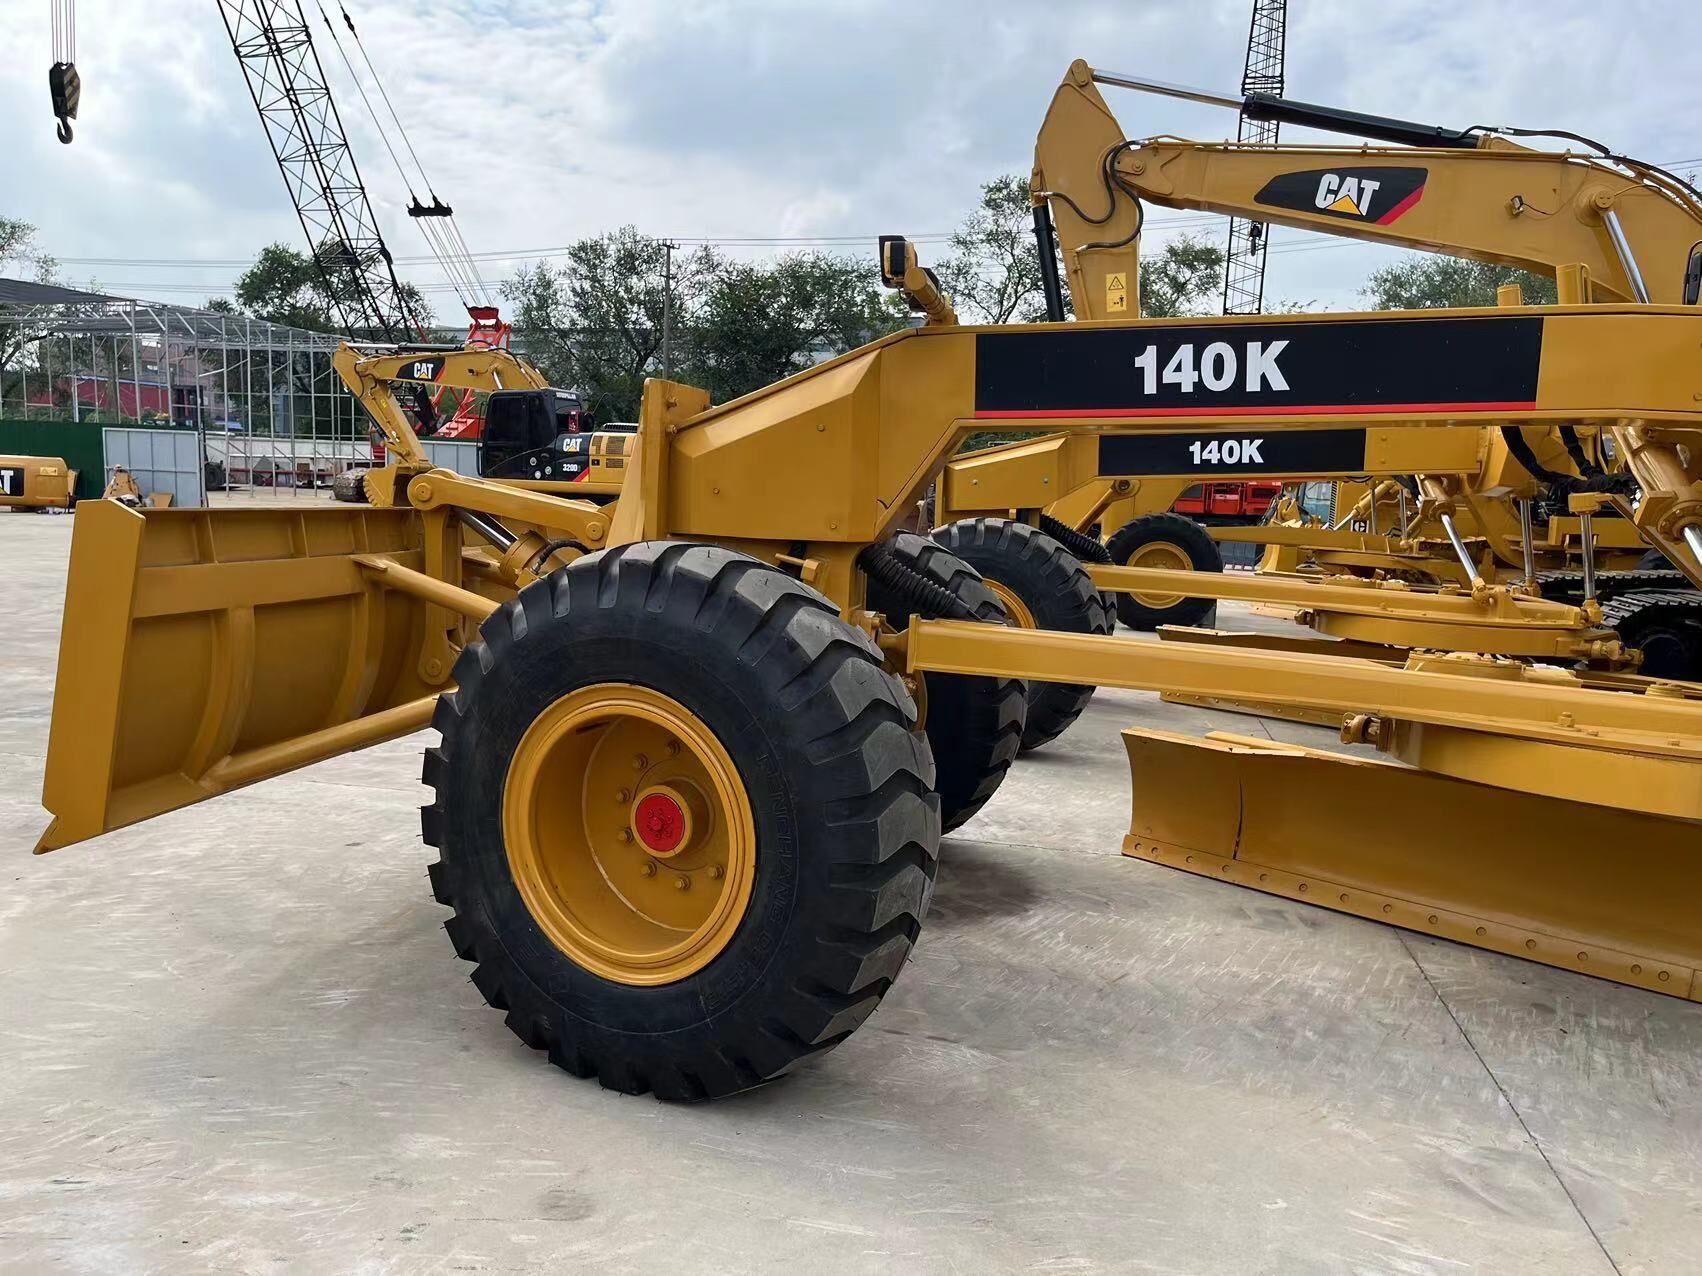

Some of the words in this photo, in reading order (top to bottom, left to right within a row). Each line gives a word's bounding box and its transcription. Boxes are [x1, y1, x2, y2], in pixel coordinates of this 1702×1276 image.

[1314, 173, 1381, 216] CAT
[414, 363, 434, 380] CAT
[1134, 339, 1290, 396] 140K
[563, 438, 582, 452] CAT
[1188, 438, 1265, 465] 140K
[0, 470, 14, 495] T
